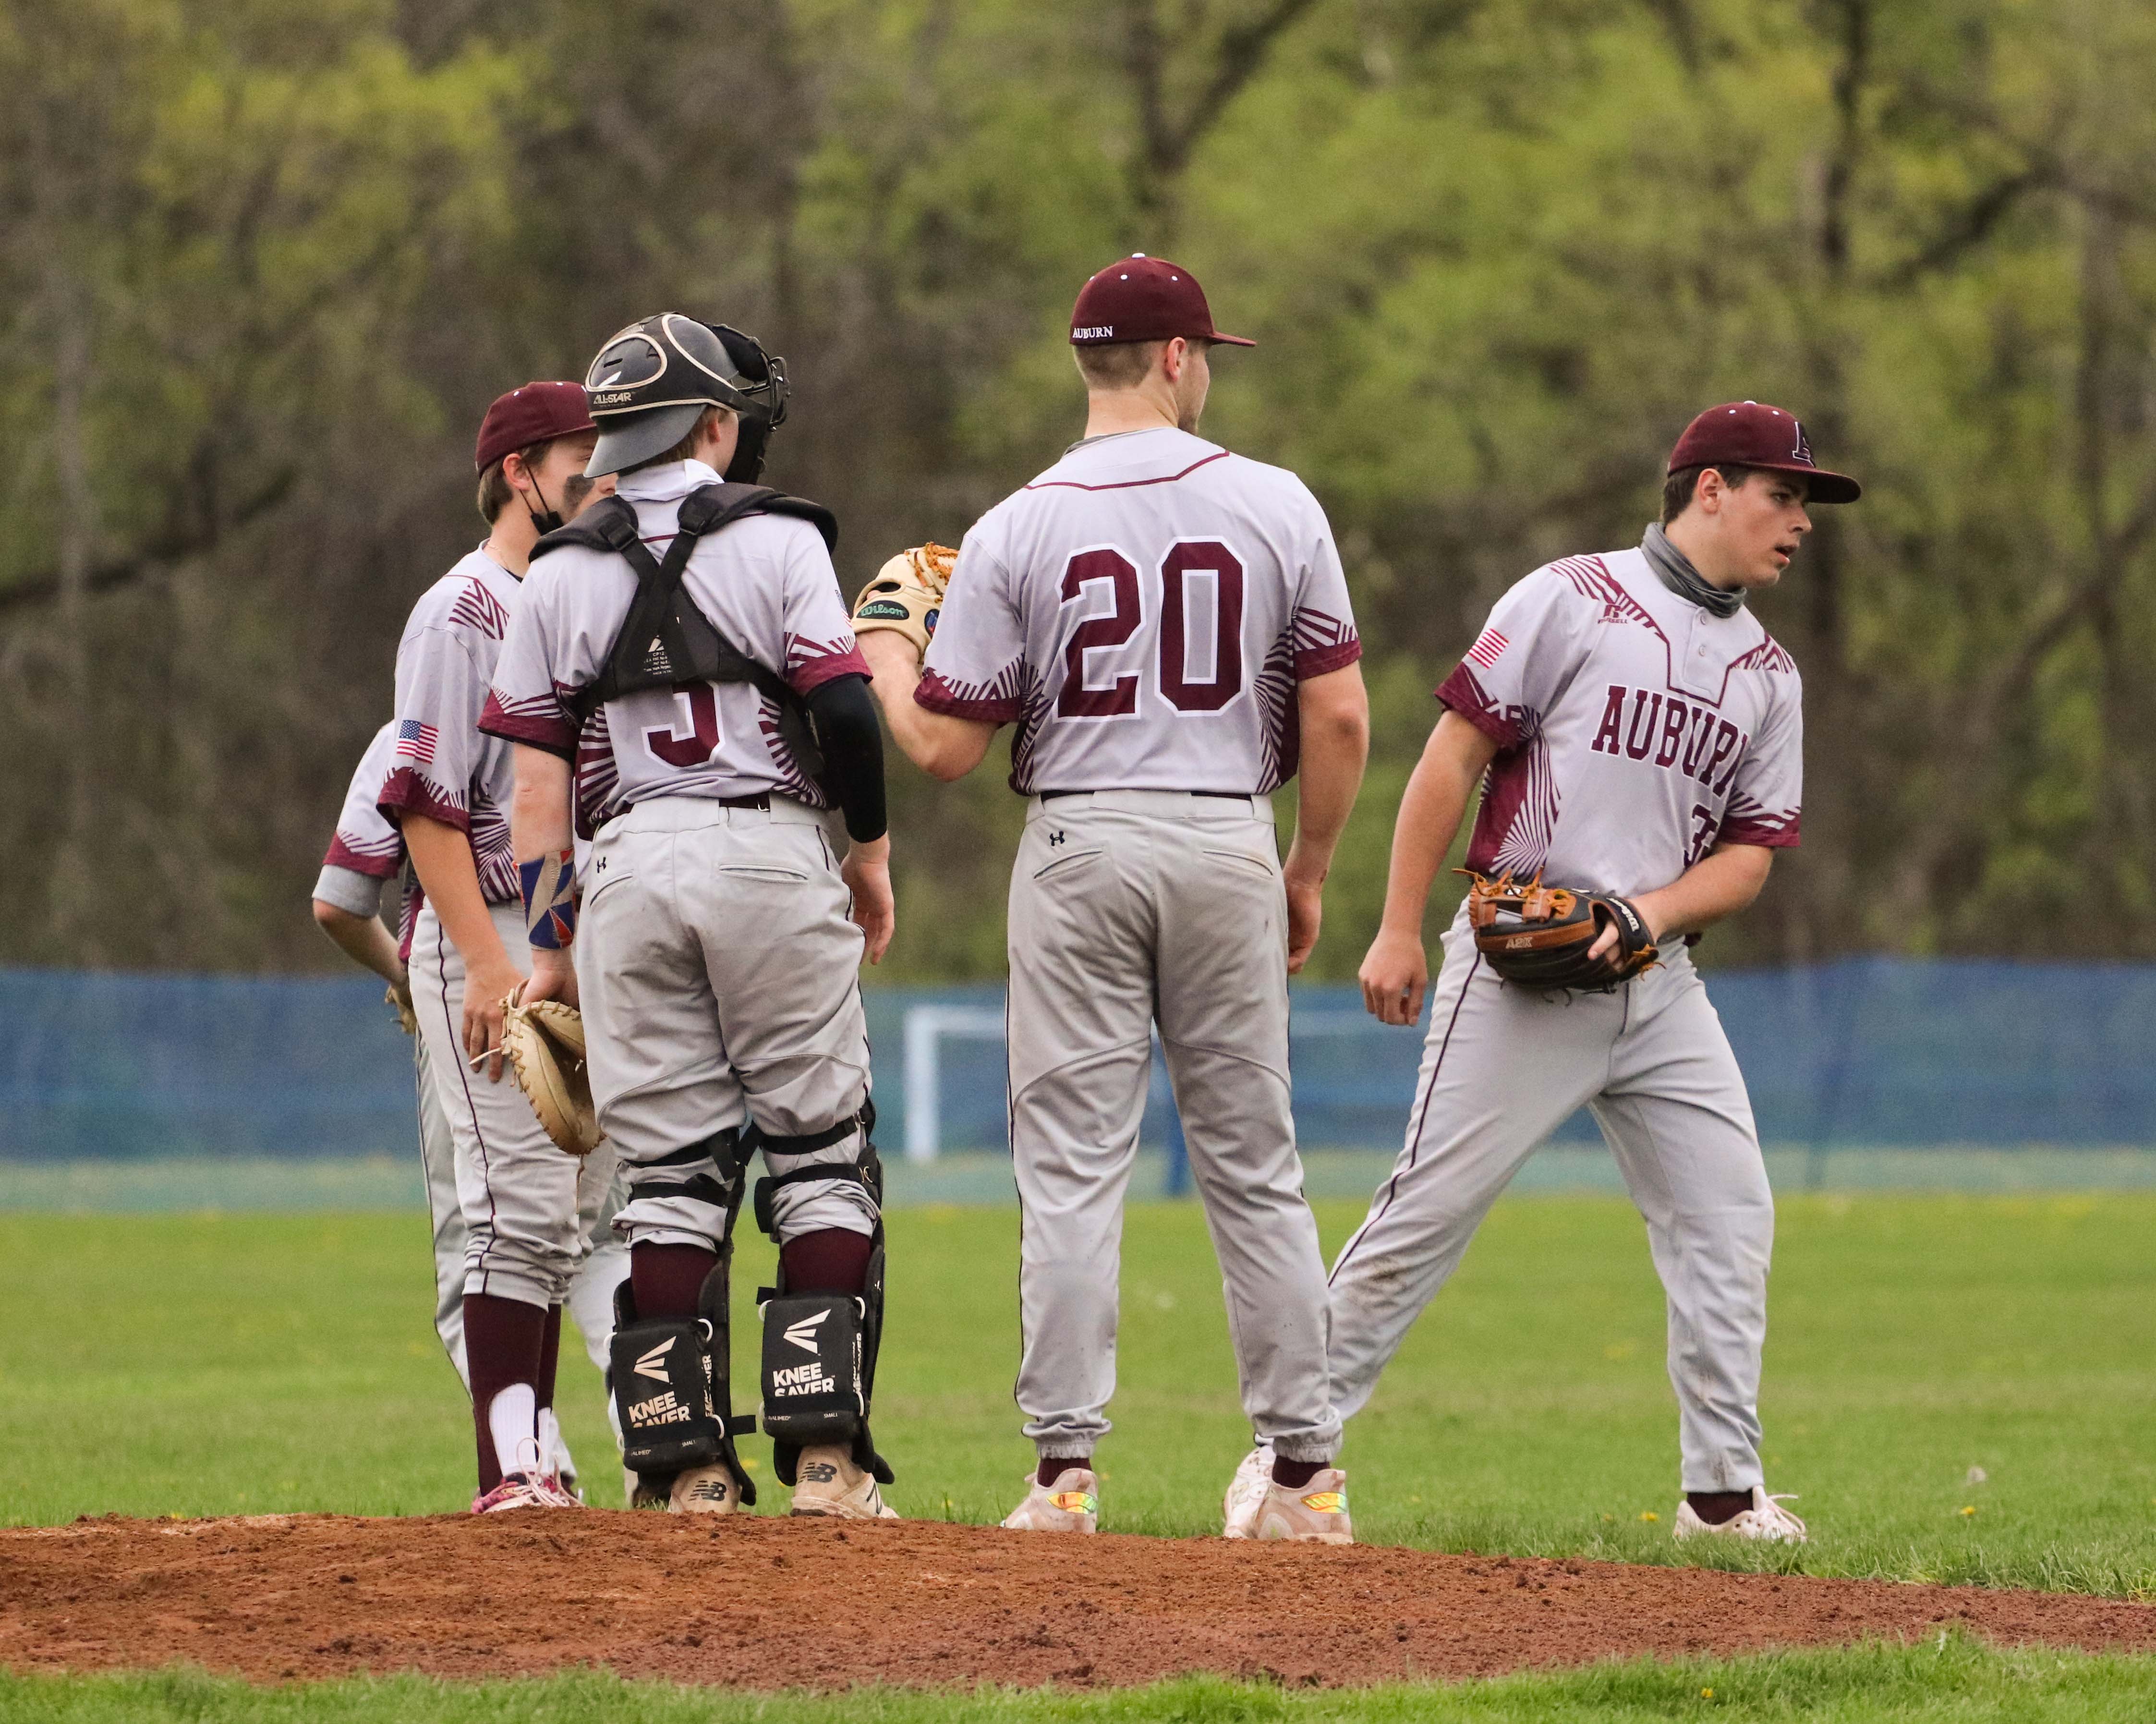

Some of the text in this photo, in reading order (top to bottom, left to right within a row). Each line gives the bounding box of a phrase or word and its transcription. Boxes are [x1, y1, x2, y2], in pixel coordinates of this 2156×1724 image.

[1073, 326, 1113, 339] AUBURN
[593, 392, 632, 404] ALL-STAR
[860, 604, 904, 618] Wilson
[1055, 536, 1248, 722] 20
[773, 1362, 823, 1387] KNEE
[629, 1391, 678, 1422] KNEE
